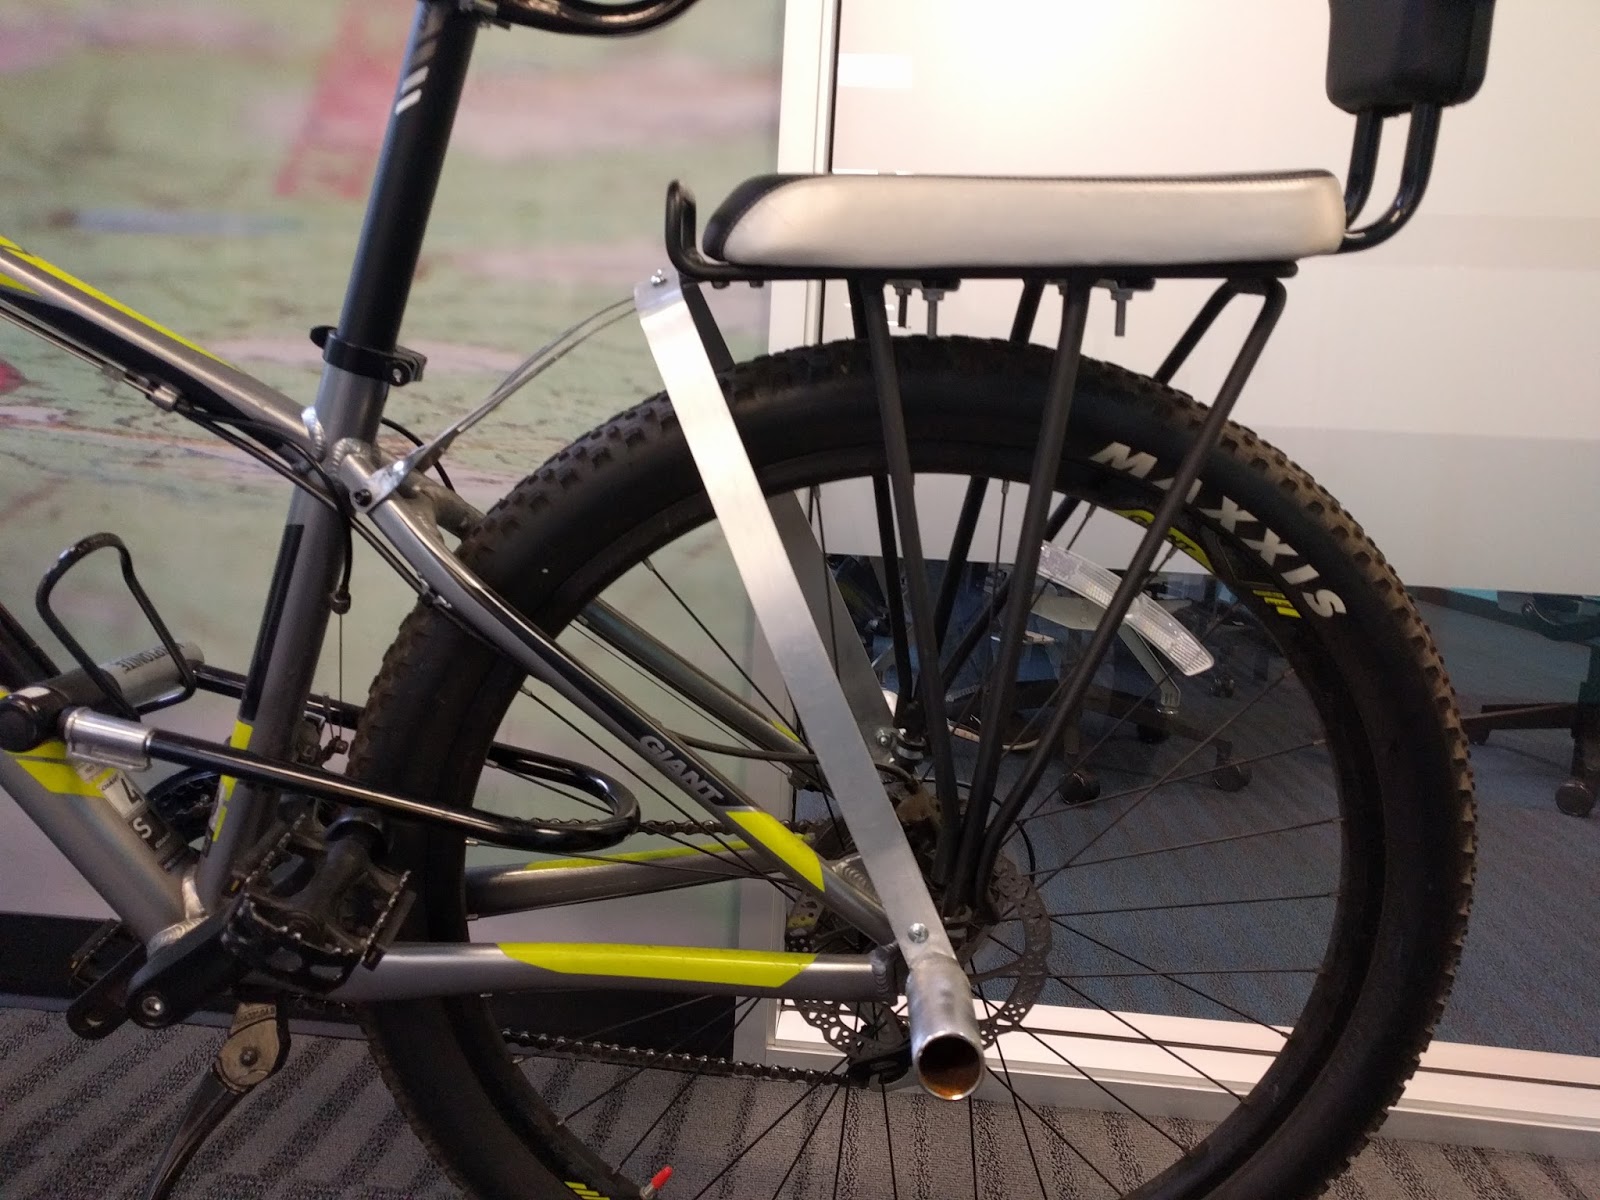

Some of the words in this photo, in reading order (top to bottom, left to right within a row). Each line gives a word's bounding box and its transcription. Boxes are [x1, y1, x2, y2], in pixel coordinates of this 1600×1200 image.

[1089, 441, 1347, 618] MAXXIS
[640, 735, 725, 804] GIANT
[132, 817, 152, 839] S
